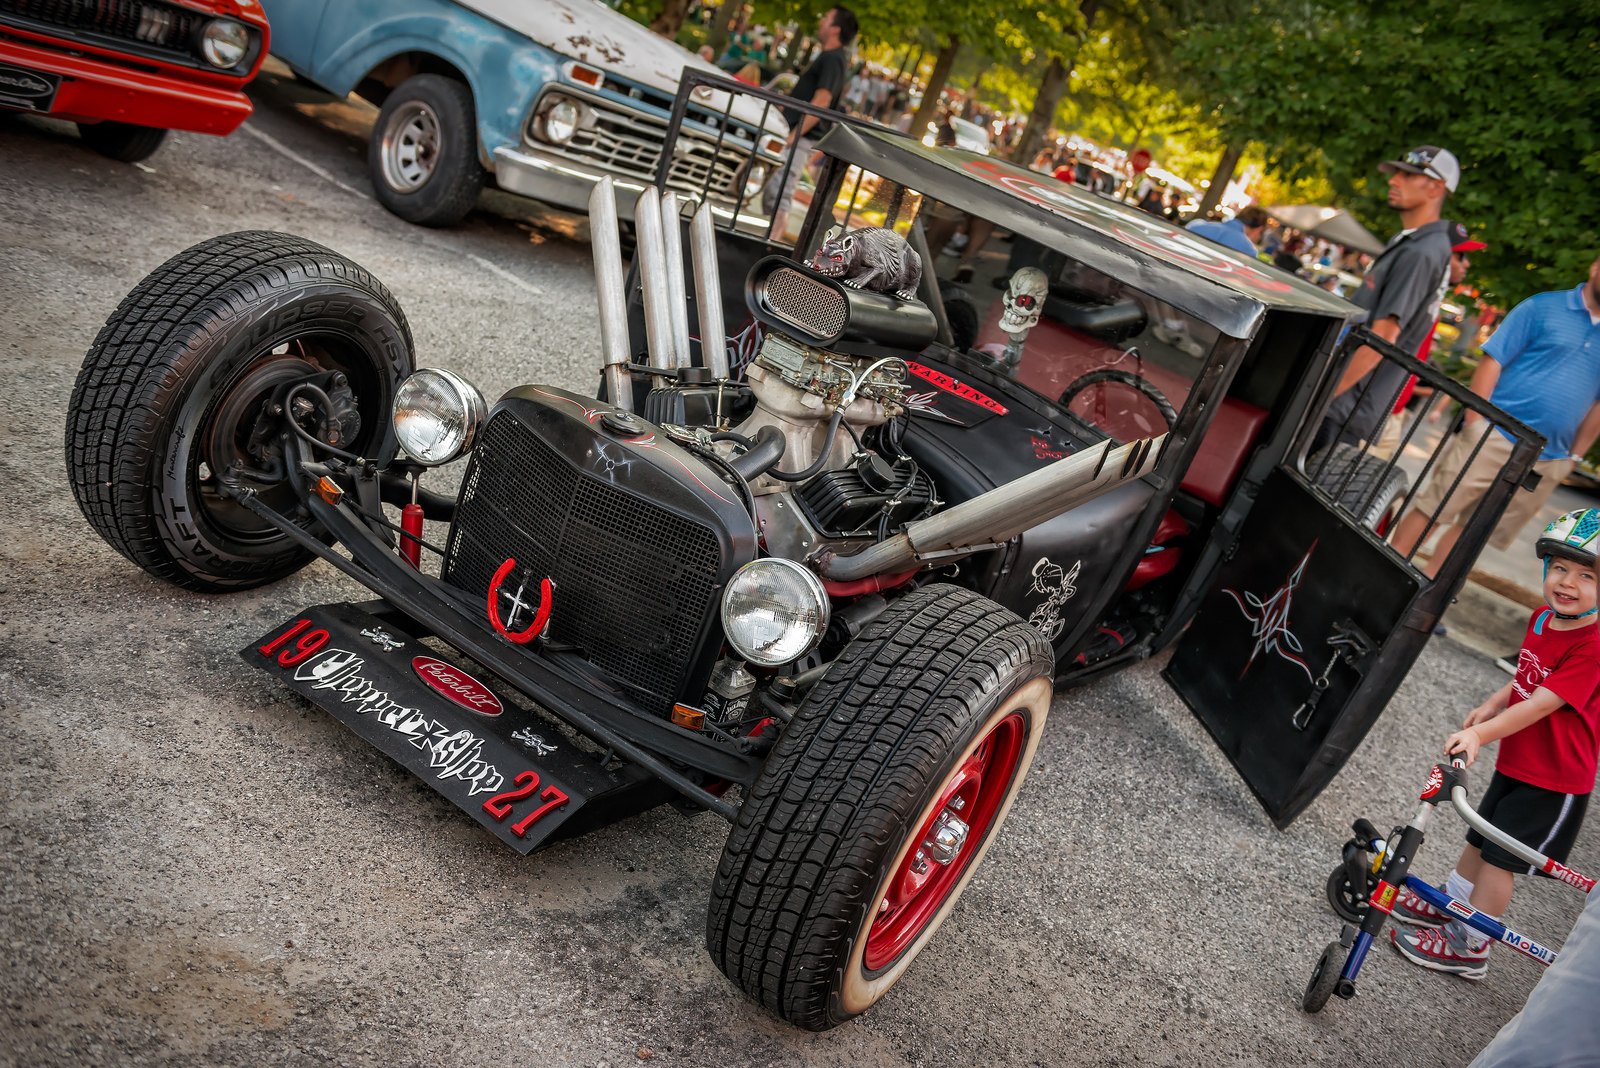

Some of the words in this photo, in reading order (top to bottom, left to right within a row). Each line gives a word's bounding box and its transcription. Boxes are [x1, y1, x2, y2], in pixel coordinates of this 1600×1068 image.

[374, 323, 406, 385] HSX
[909, 361, 999, 406] WARNING
[417, 661, 501, 709] Peterbilt
[259, 619, 331, 669] 19
[431, 729, 505, 797] Shop
[482, 770, 570, 838] 27
[1505, 929, 1548, 962] Mobil
